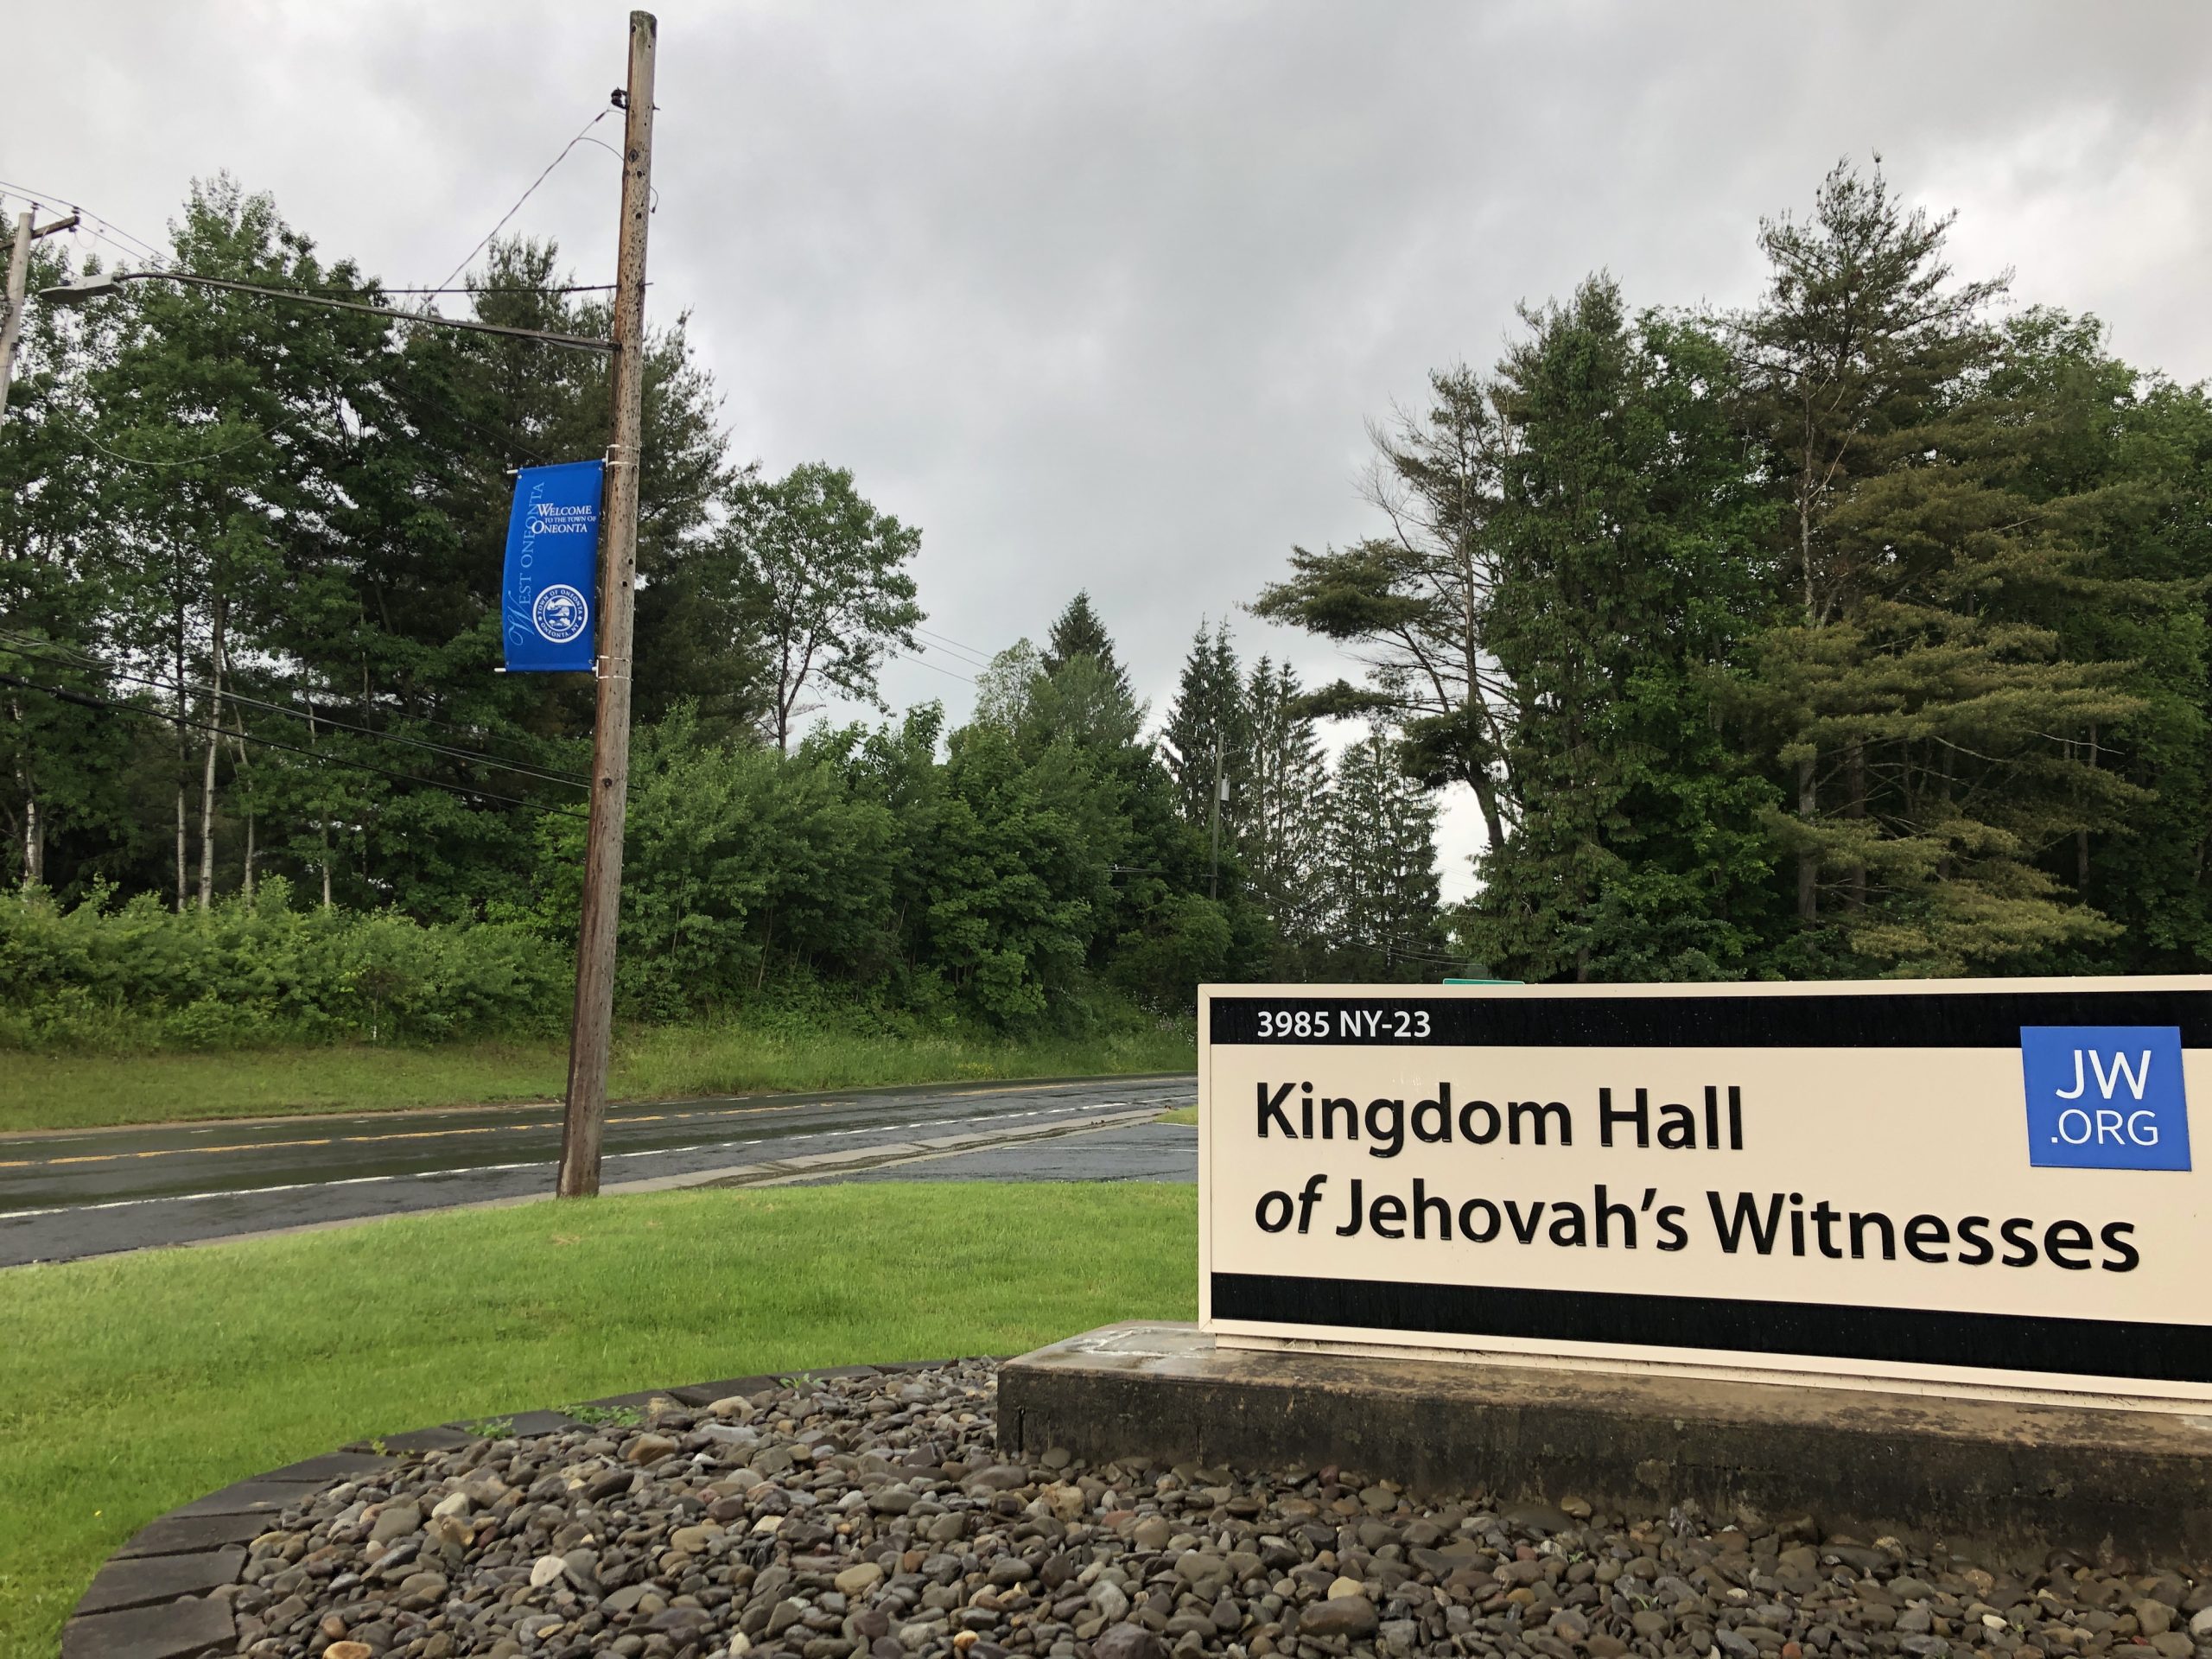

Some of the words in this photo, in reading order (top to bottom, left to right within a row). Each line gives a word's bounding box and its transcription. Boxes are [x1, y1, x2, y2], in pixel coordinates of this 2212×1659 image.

[520, 482, 545, 569] ONEONTA
[536, 503, 593, 517] WELCOME
[531, 520, 588, 534] ONEONTA
[537, 596, 549, 614] TOWN
[560, 589, 583, 614] ONEONTA
[572, 623, 580, 633] NY
[1257, 1011, 1330, 1038] 3985
[1340, 1010, 1431, 1038] NY-23
[2055, 1049, 2152, 1100] JW
[1256, 1081, 1573, 1159] Kingdom
[1599, 1085, 1743, 1151] Hall
[2051, 1109, 2158, 1146] .ORG
[1255, 1173, 1328, 1235] of
[1335, 1178, 1688, 1252] Jehovah's
[1706, 1191, 2140, 1273] Witnesses
